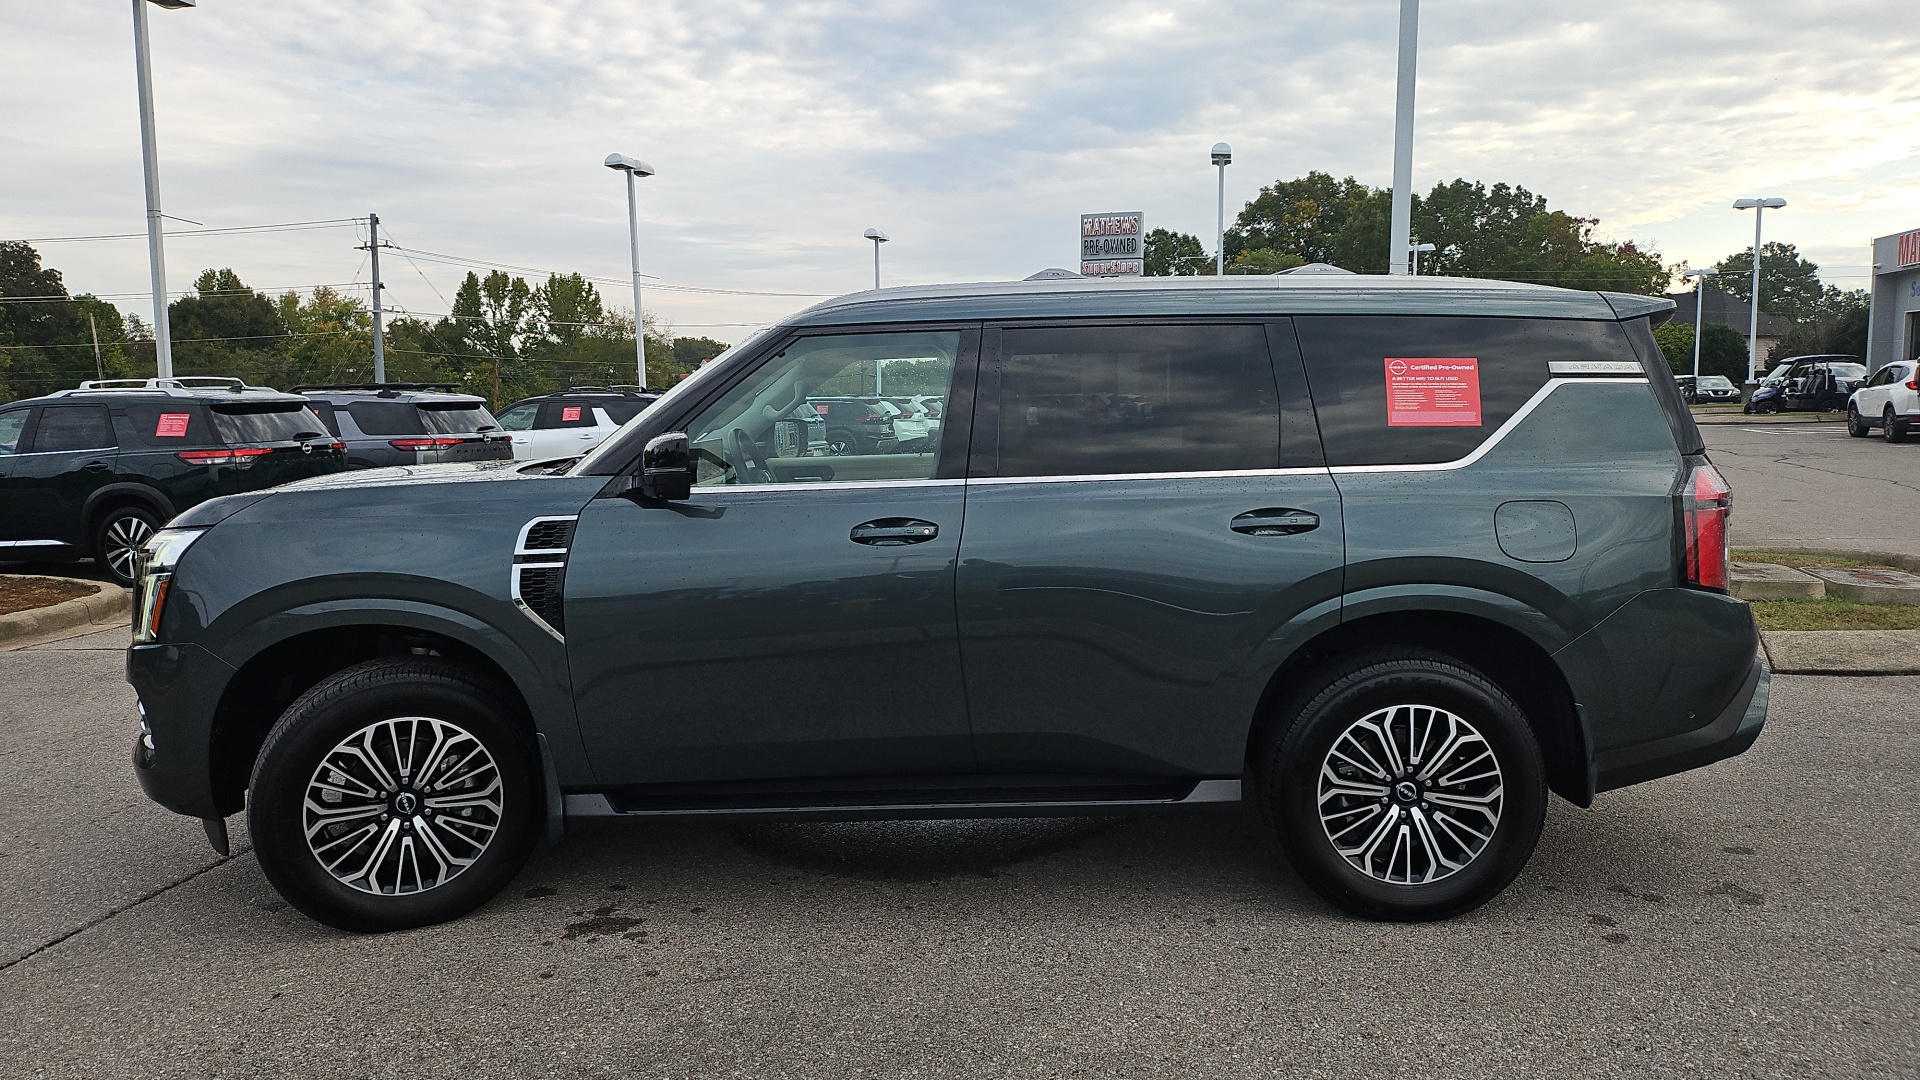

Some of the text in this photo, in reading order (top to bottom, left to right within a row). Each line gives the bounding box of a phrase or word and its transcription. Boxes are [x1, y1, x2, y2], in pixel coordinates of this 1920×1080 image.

[1082, 216, 1138, 236] MATHEWS
[1083, 238, 1137, 255] PRE-OWNED
[1082, 260, 1139, 276] SuperStore
